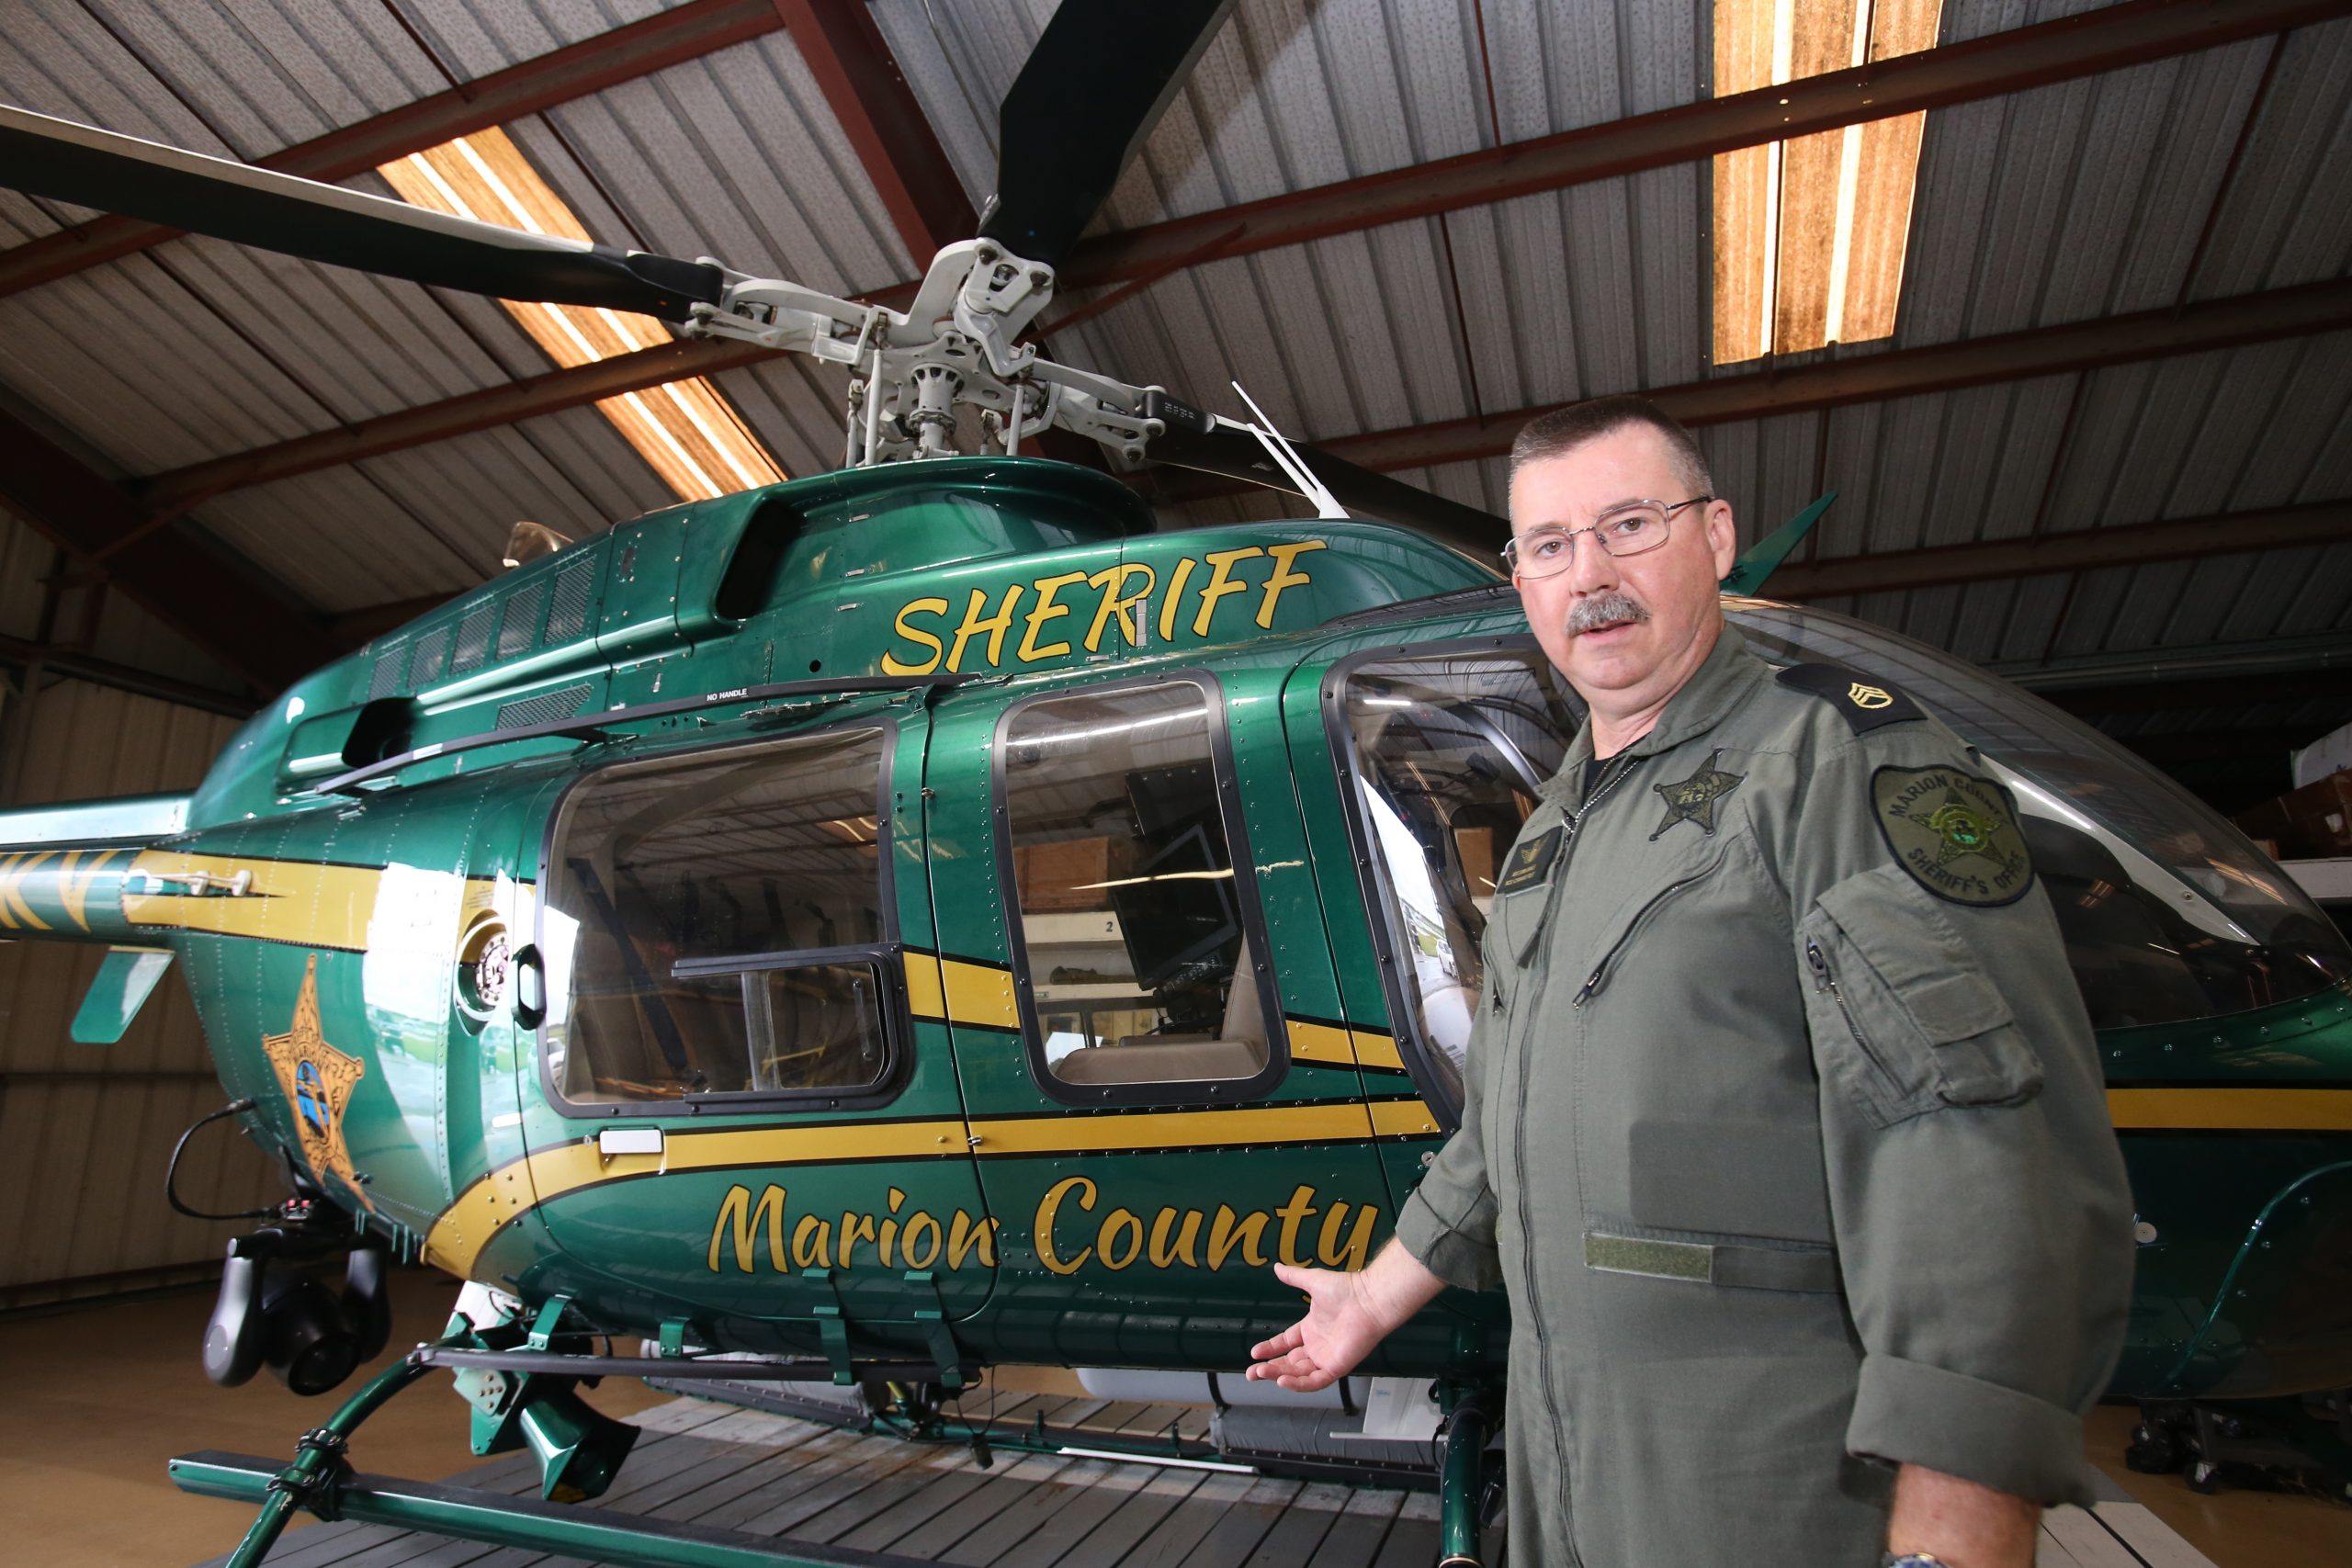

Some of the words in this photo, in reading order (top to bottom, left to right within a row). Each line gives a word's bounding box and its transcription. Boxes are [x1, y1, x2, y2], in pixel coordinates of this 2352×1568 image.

[880, 538, 1329, 676] SHERIFF
[707, 693, 718, 701] NO
[719, 688, 747, 699] HANDLE
[1889, 774, 1949, 818] MARION
[1908, 847, 1988, 895] SHERIFF'S
[1105, 920, 1114, 932] 2
[707, 1182, 1001, 1275] Marion
[1034, 1175, 1380, 1303] County
